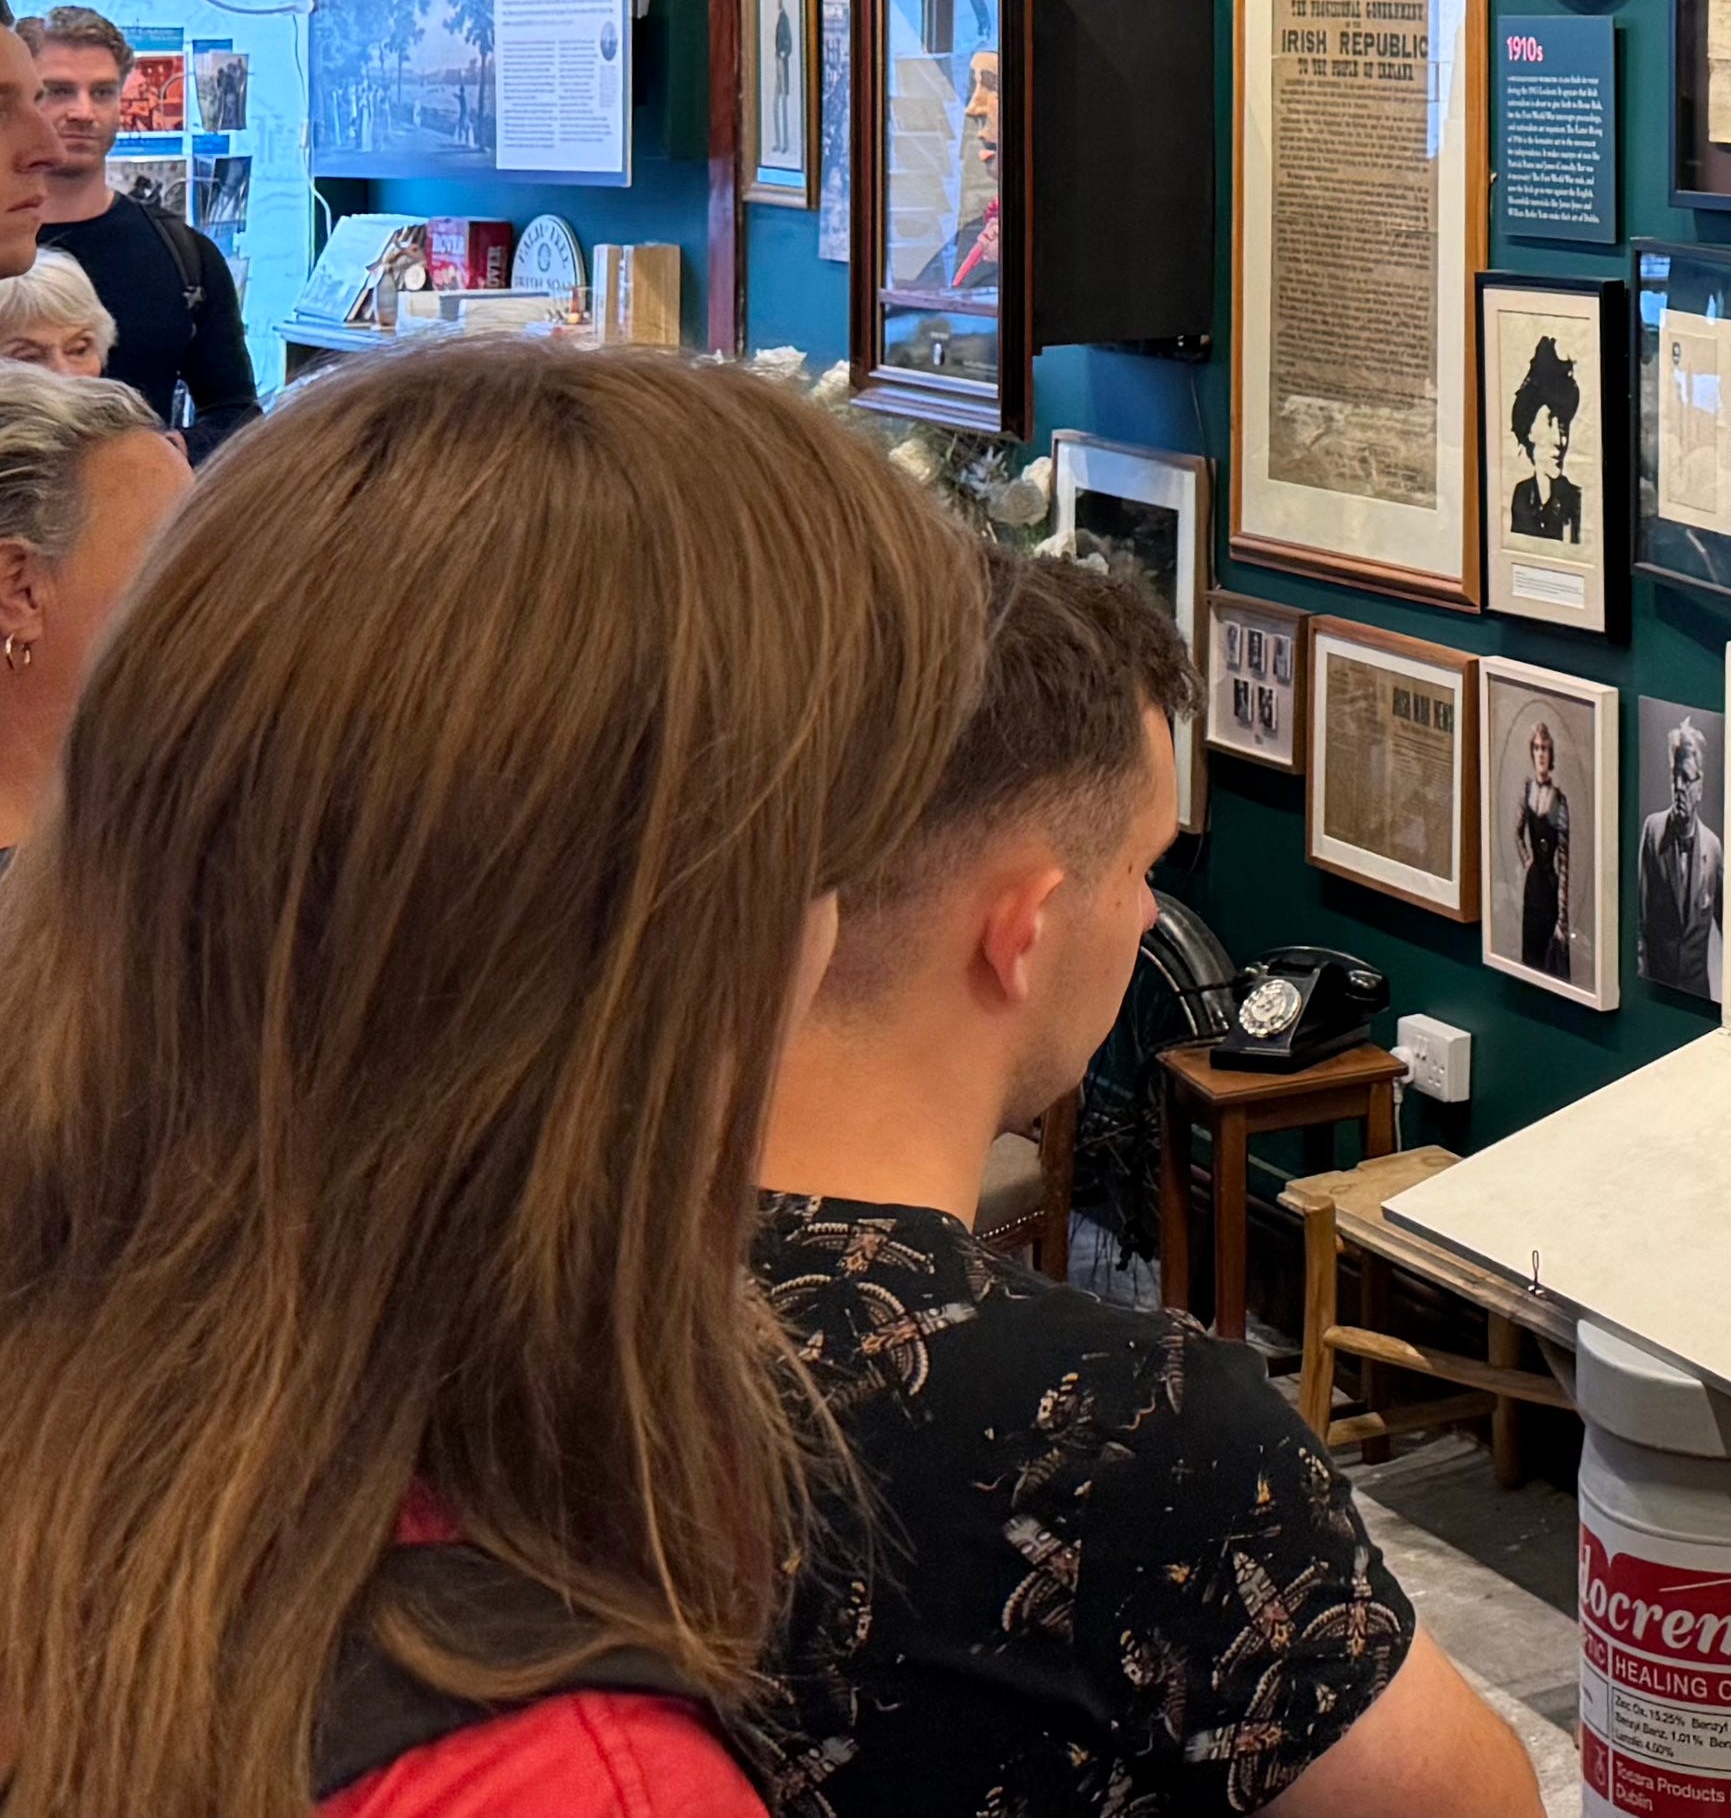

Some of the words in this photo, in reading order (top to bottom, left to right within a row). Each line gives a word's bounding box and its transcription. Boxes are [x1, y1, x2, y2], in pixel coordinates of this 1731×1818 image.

[1281, 29, 1327, 54] IRISH
[1339, 31, 1428, 58] REPUBLIC
[1506, 36, 1544, 62] 1910s
[1615, 1653, 1708, 1698] HEALING
[1616, 1782, 1653, 1812] Dublin
[1657, 1775, 1725, 1803] Products
